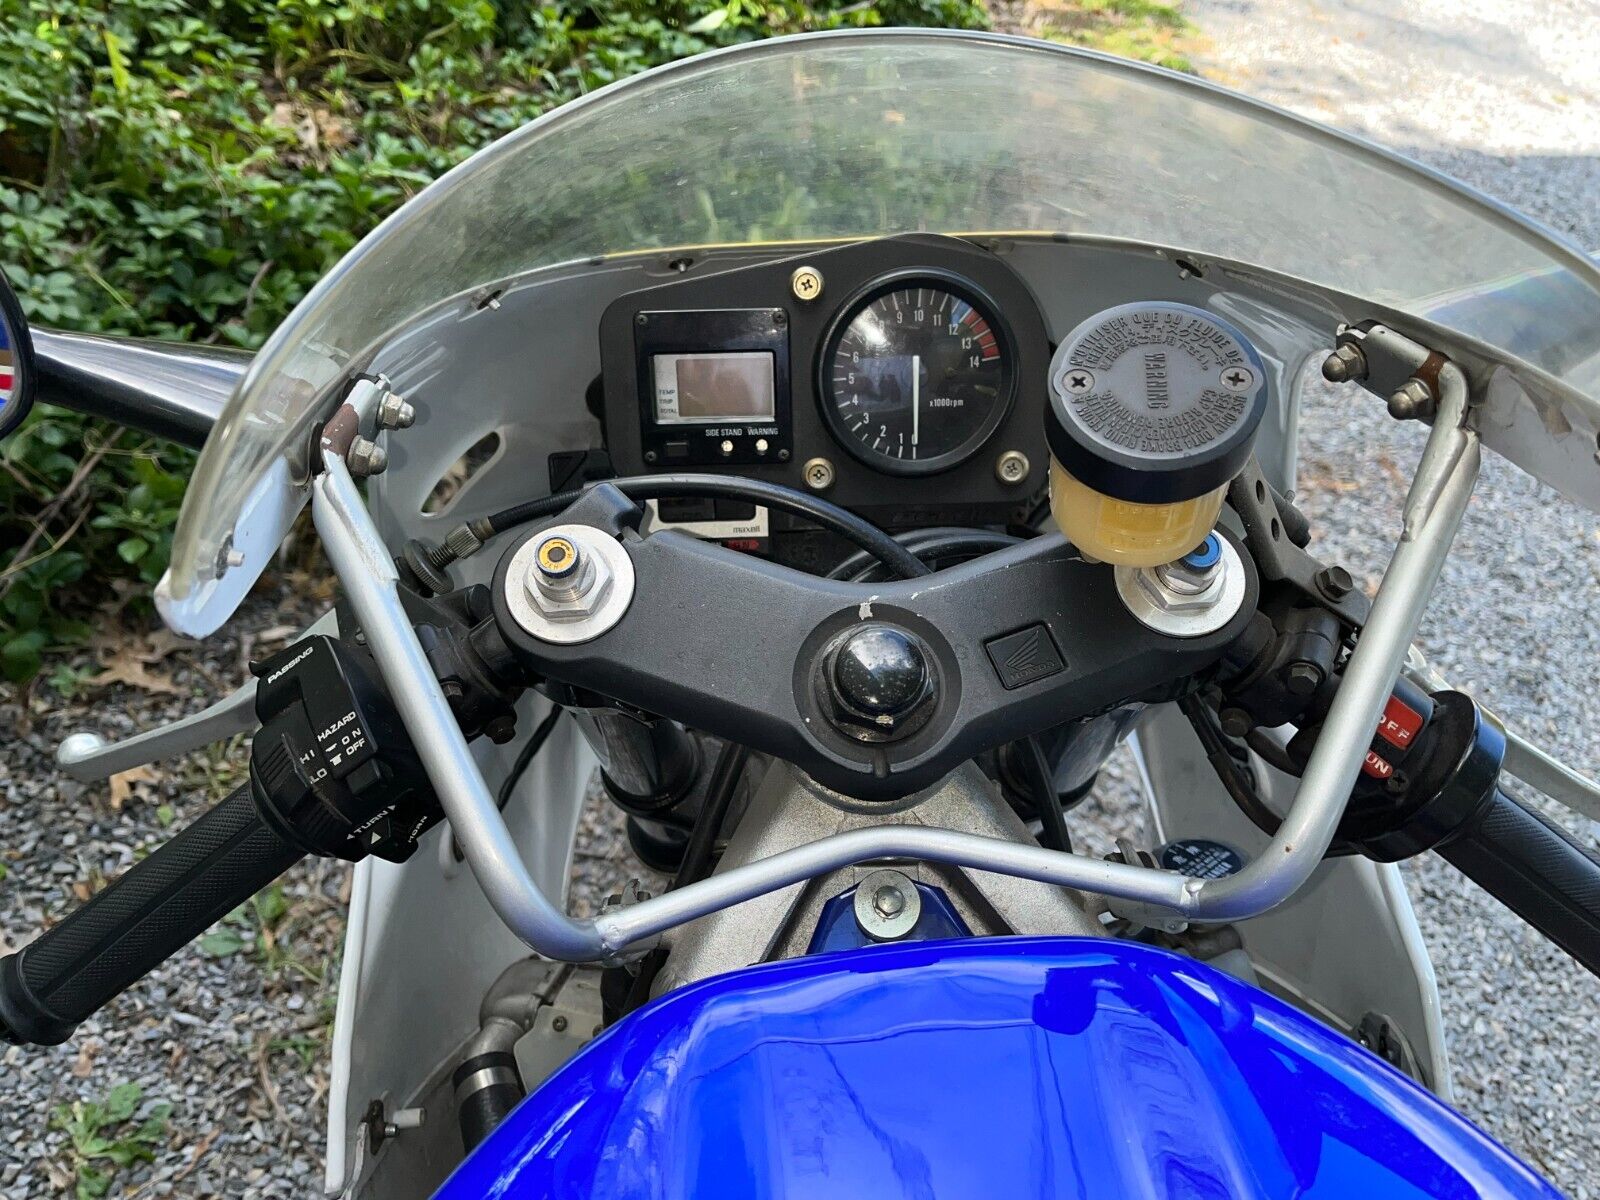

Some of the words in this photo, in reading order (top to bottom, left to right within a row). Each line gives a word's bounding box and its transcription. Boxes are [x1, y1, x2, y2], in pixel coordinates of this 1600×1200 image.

[896, 311, 903, 324] 9
[914, 309, 924, 322] 10
[933, 314, 942, 327] 11
[948, 323, 958, 336] 12
[1133, 312, 1159, 324] QUE
[1187, 319, 1231, 349] FLUIDE
[1225, 350, 1244, 364] DE
[962, 337, 972, 350] 13
[852, 351, 859, 363] 6
[969, 355, 980, 368] 14
[848, 372, 855, 384] 5
[1145, 353, 1168, 409] WARNING
[852, 394, 859, 405] 4
[1199, 390, 1217, 410] CAP
[1203, 393, 1231, 423] SEALED
[1229, 396, 1247, 414] USE
[863, 412, 870, 424] 3
[1076, 407, 1105, 432] FROM
[1158, 407, 1203, 429] BEFORE
[1212, 412, 1237, 435] ONLY
[705, 429, 719, 437] SIDE
[721, 428, 742, 436] STAND
[747, 427, 778, 436] WARNING
[880, 425, 887, 437] 2
[1104, 429, 1137, 449] FLUID
[1141, 440, 1183, 452] BRAKE
[267, 646, 314, 684] PASSING
[1010, 660, 1055, 681] HONDA
[317, 711, 356, 742] HAZARD
[346, 737, 366, 756] OFF
[300, 749, 315, 765] HI
[310, 767, 328, 785] LO
[353, 810, 388, 835] TURN
[407, 815, 428, 843] HORN
